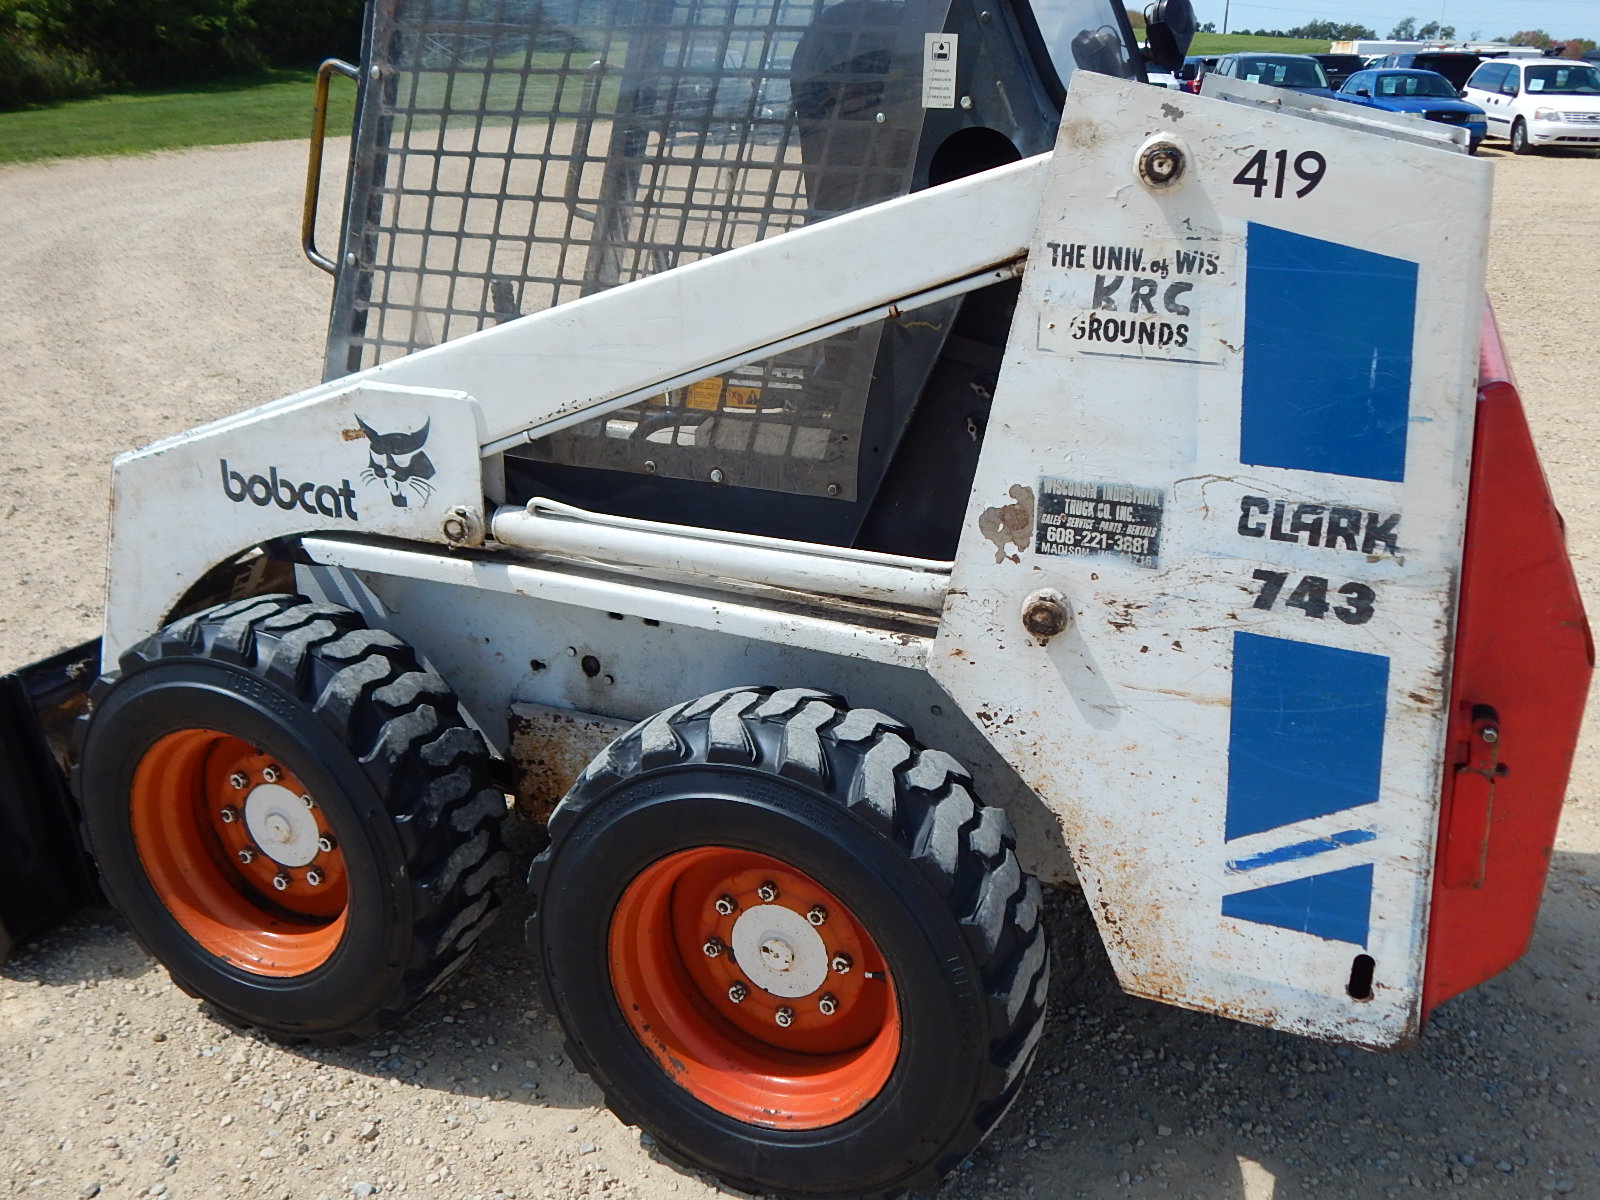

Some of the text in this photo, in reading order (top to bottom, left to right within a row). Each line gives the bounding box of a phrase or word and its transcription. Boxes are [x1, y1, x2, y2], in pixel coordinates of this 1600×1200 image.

[1233, 149, 1327, 198] 419
[1047, 242, 1086, 269] THE
[1092, 245, 1146, 272] UNIV.
[1092, 274, 1194, 317] KRC
[1070, 312, 1189, 347] GROUNDS
[220, 458, 358, 521] bobcat
[1064, 498, 1136, 522] TRUCK CO. INC.
[1066, 517, 1096, 530] SERVICE
[1238, 495, 1402, 556] CLARK
[1041, 542, 1089, 557] MADISON
[1252, 569, 1376, 625] 743
